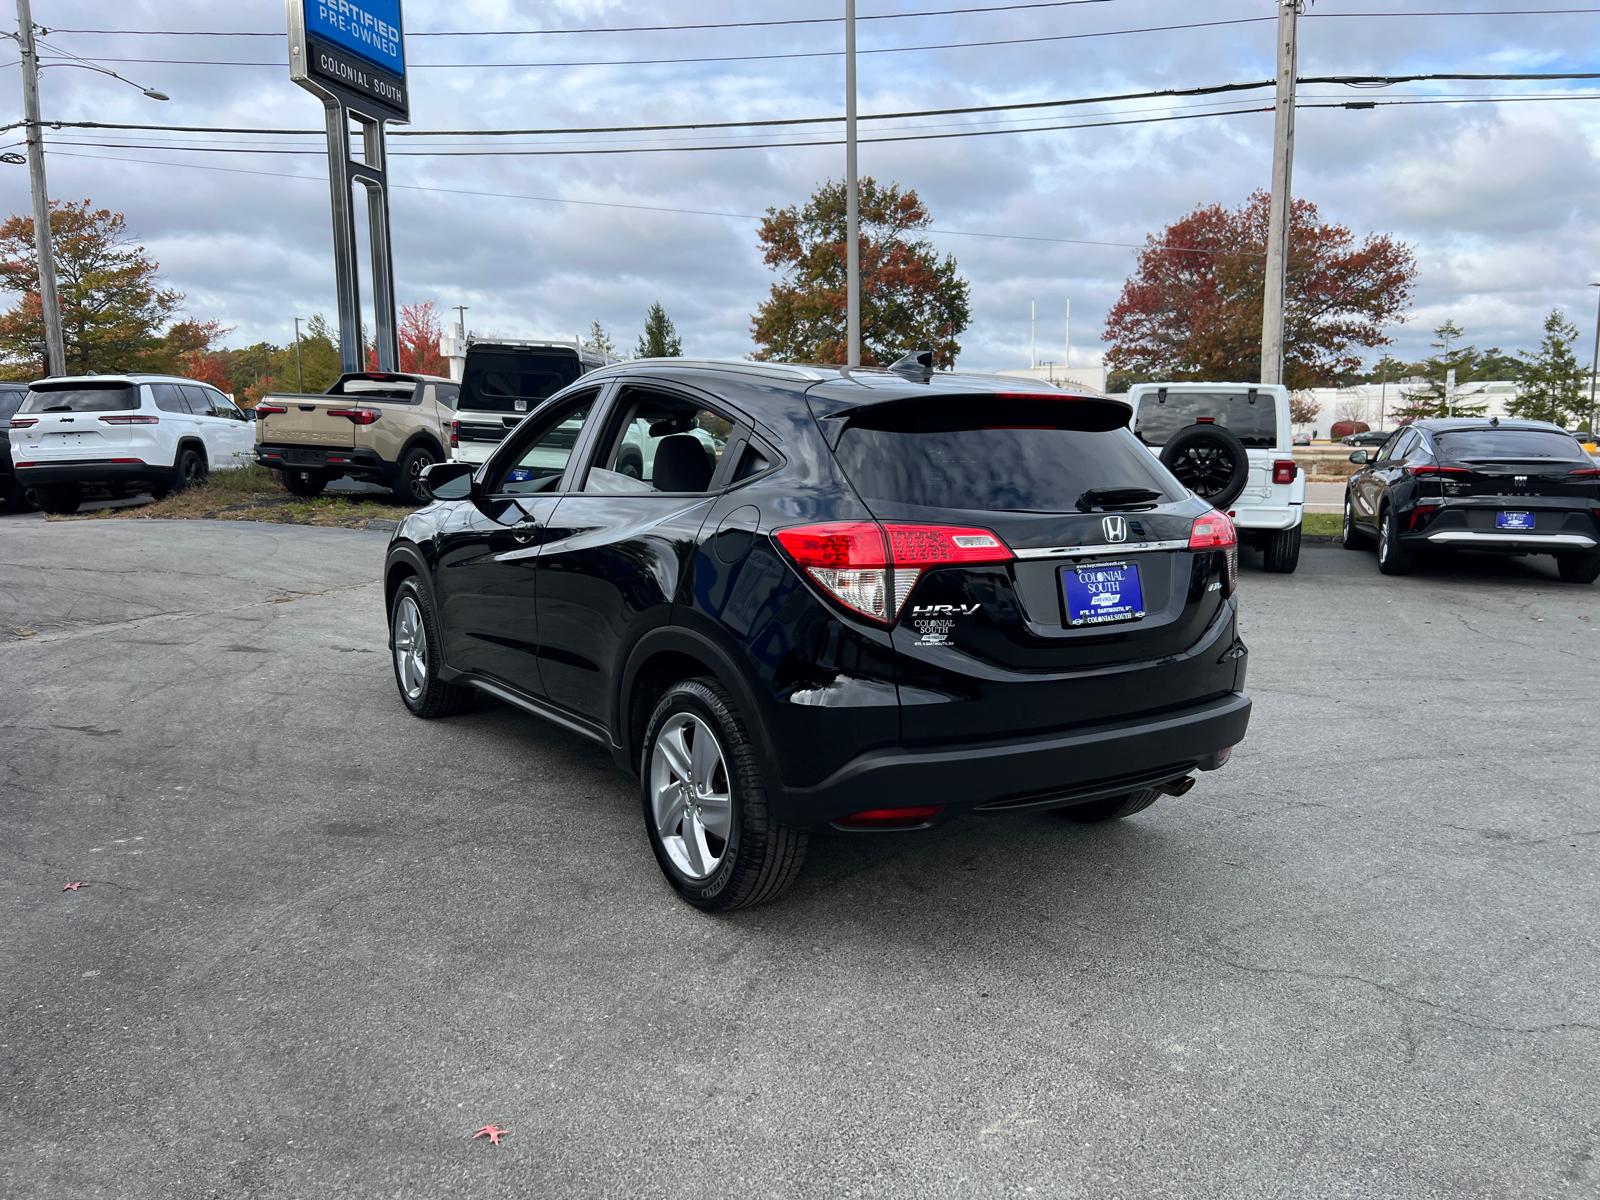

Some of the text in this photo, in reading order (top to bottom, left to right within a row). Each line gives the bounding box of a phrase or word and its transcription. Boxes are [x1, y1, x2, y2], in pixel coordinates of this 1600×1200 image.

[318, 0, 399, 43] ERTIFIED
[319, 5, 397, 57] PRE-OWNED
[320, 54, 402, 103] COLONIAL SOUTH
[266, 429, 349, 442] SANTA CRUZ
[1079, 571, 1125, 583] COLONIAL
[1088, 582, 1119, 593] SOUTH
[911, 603, 981, 617] HR-V
[914, 619, 955, 628] COLONIAL
[1088, 615, 1114, 623] COLONIAL
